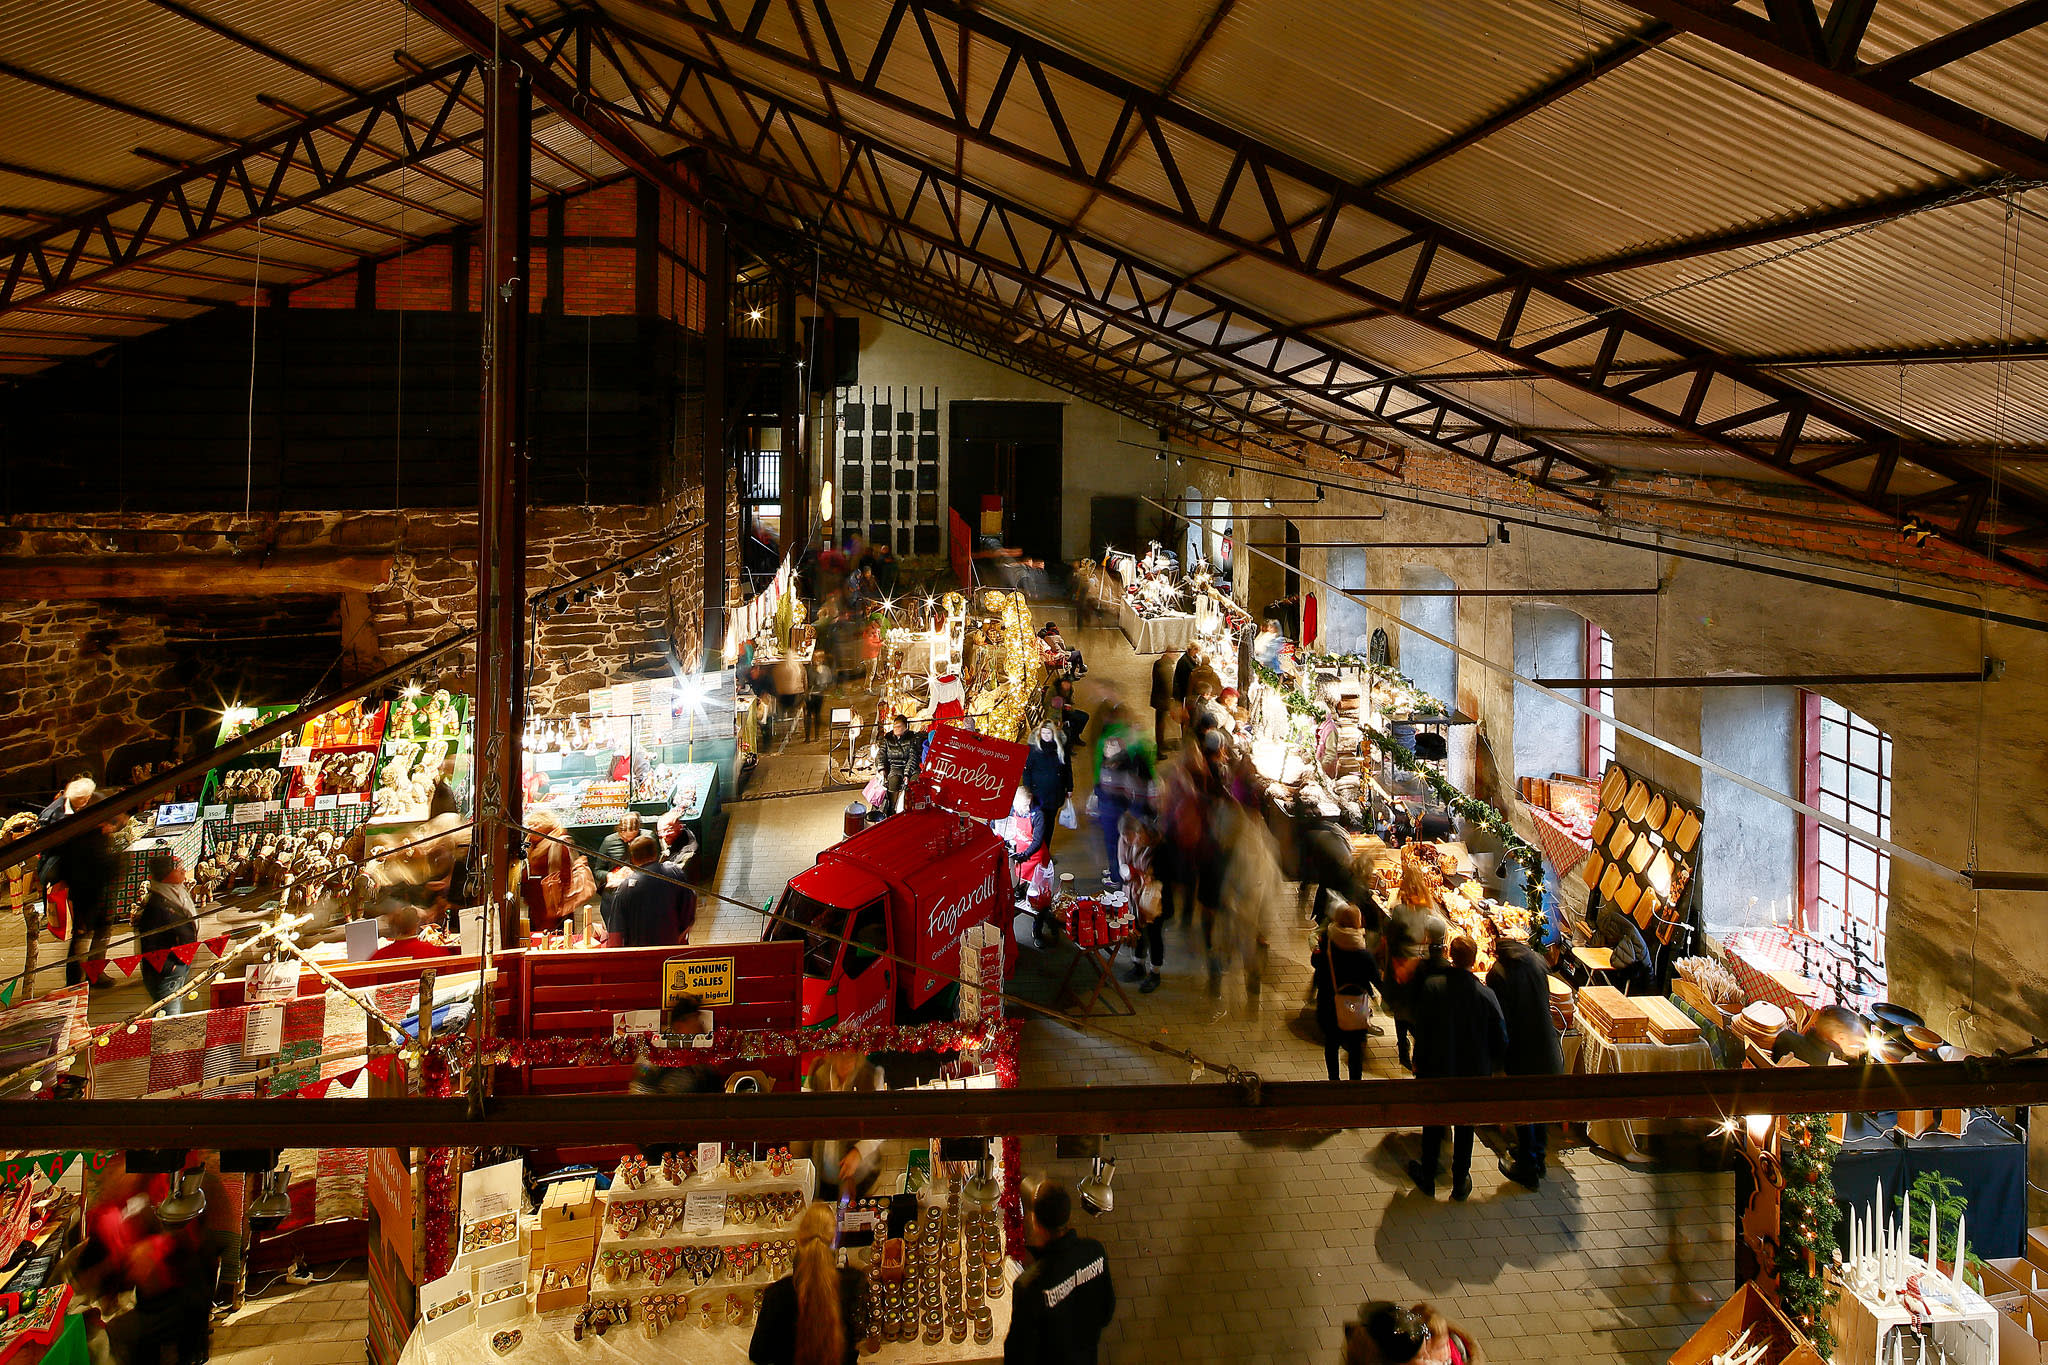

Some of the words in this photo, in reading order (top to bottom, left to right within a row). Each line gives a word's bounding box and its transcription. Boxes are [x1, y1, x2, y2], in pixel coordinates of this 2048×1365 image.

[935, 758, 1005, 801] Fogarolli
[927, 870, 995, 938] Fogarolli
[688, 963, 728, 975] HONUNG
[692, 975, 724, 987] SÄLJES
[705, 990, 729, 1000] bigård
